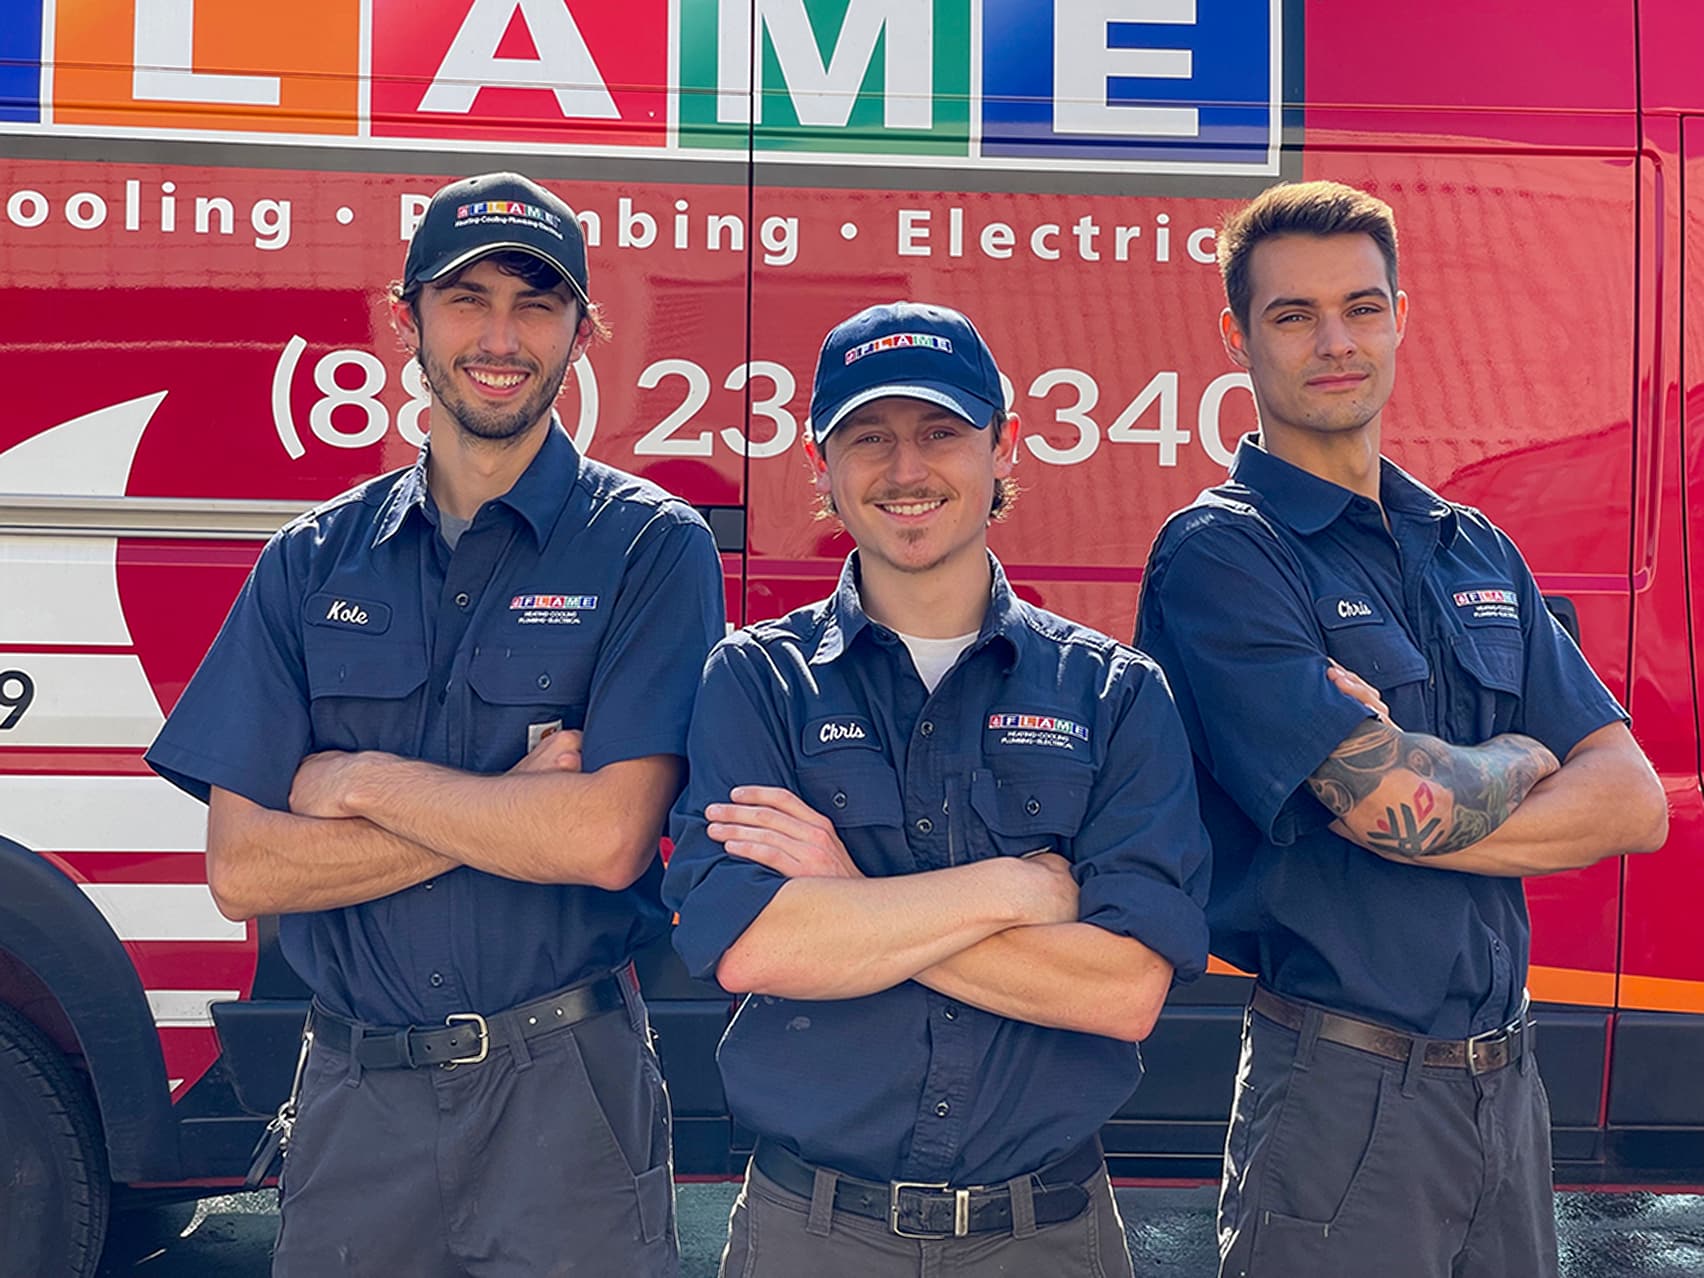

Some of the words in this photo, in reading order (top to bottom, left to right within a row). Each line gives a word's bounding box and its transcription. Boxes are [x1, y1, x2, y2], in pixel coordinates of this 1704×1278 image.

[326, 600, 369, 624] Kole
[1338, 600, 1372, 618] Chris
[820, 722, 866, 742] Chris
